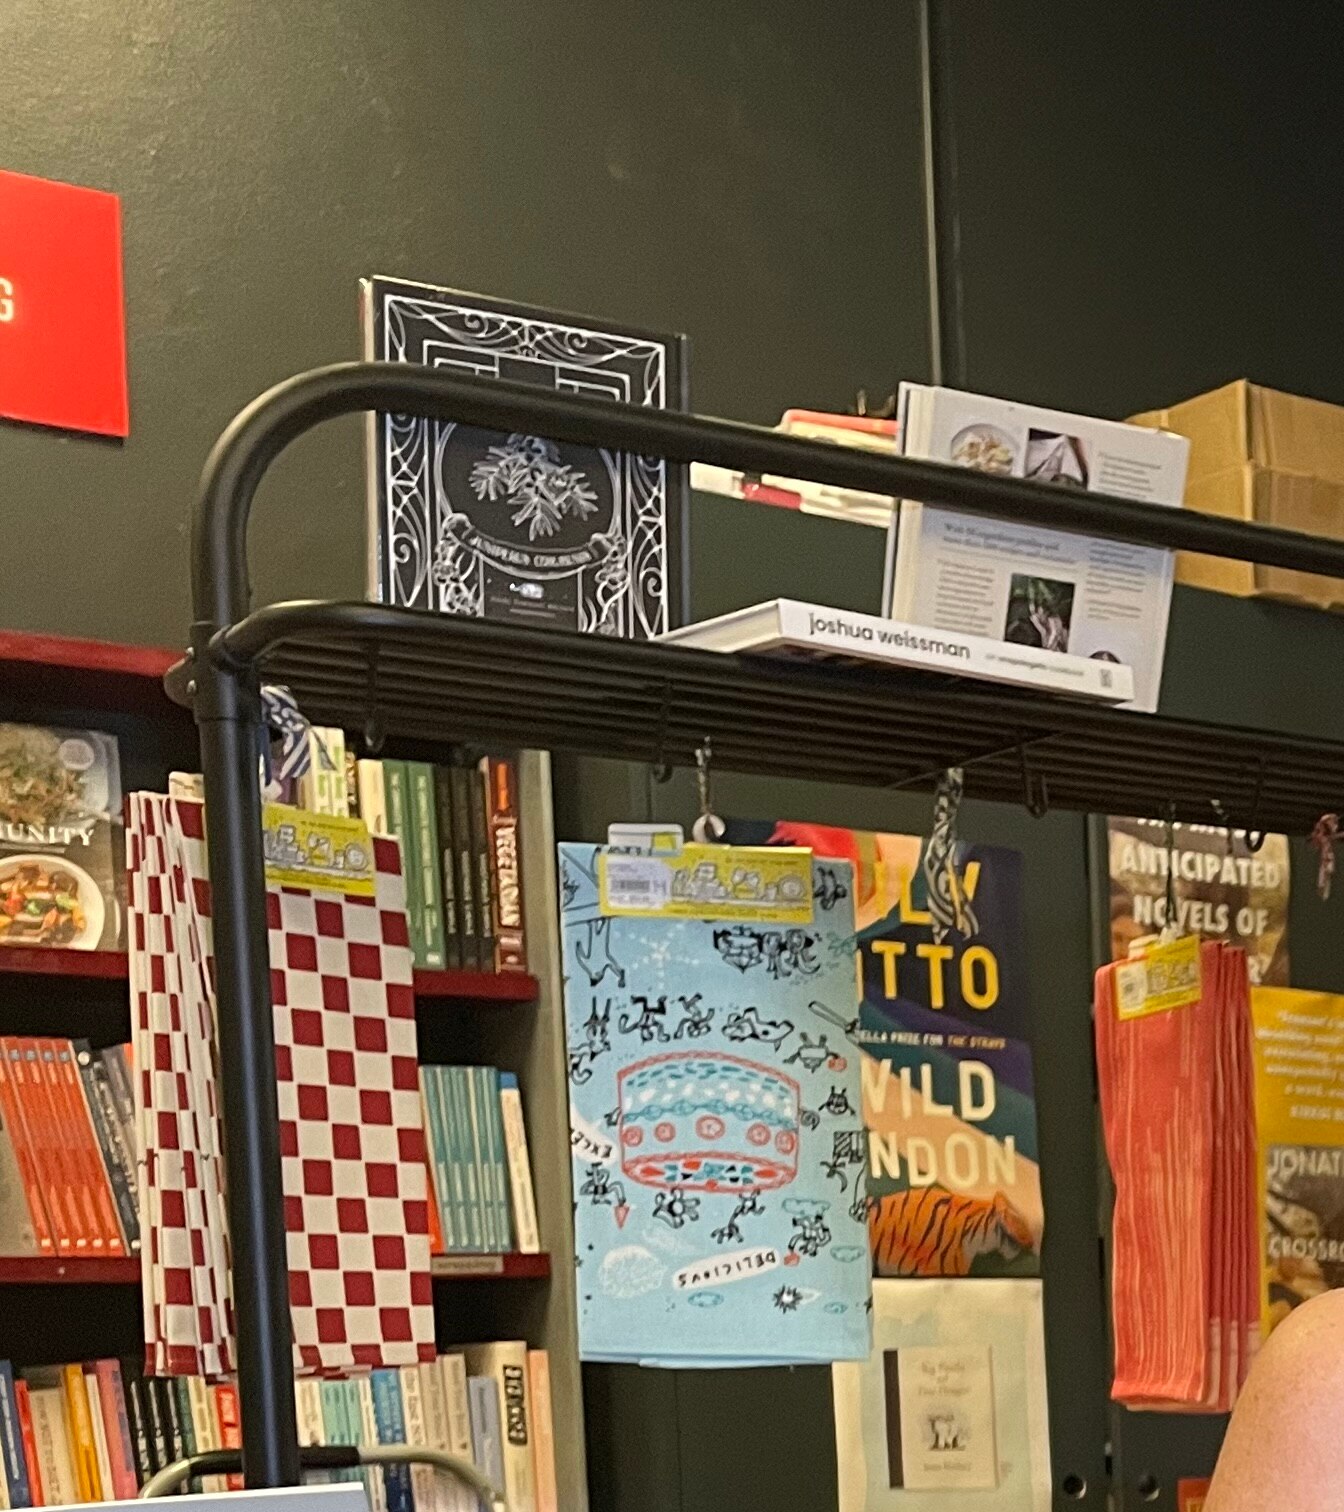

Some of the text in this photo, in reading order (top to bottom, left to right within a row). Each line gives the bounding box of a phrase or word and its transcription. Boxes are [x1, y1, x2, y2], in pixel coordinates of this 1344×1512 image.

[808, 612, 972, 660] joshua weissman
[0, 819, 95, 846] UNITY
[1120, 843, 1281, 888] ANTICIPATED
[1134, 895, 1269, 936] NOVELS OF
